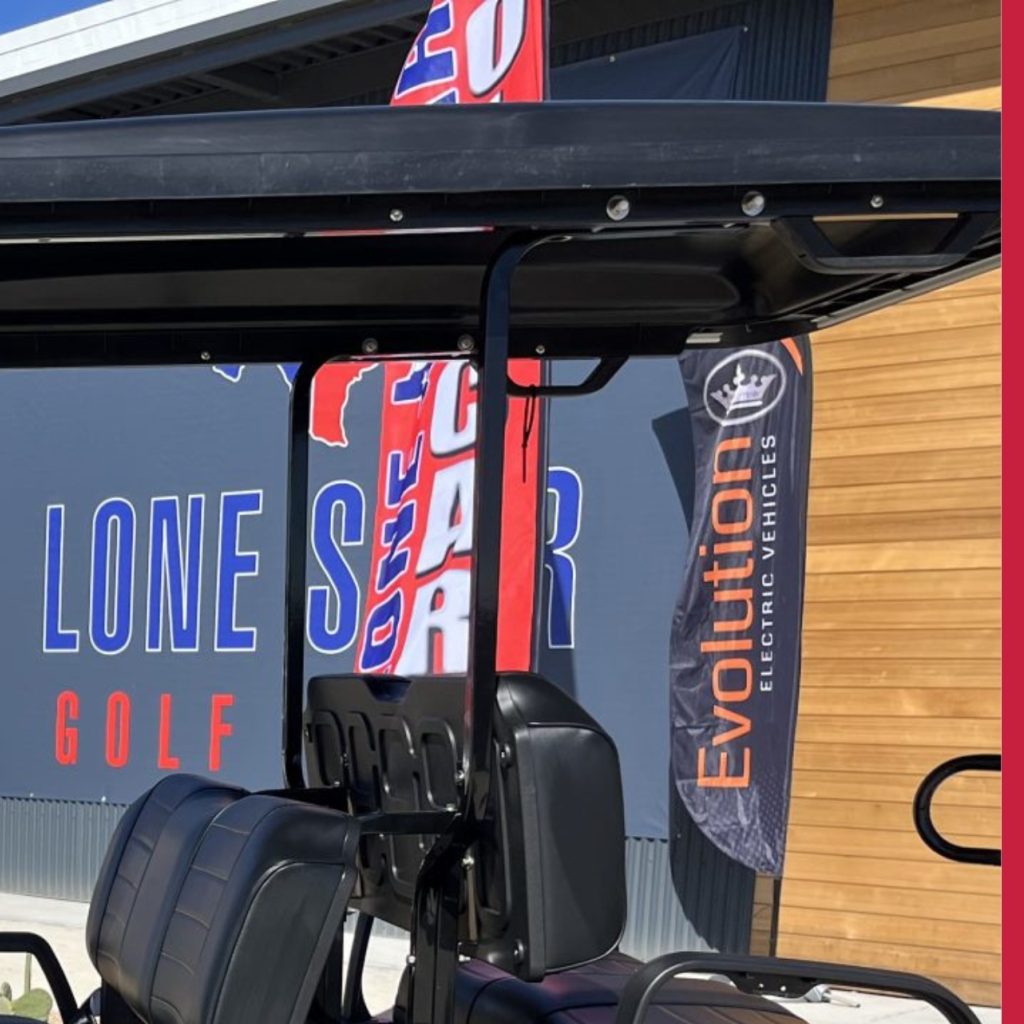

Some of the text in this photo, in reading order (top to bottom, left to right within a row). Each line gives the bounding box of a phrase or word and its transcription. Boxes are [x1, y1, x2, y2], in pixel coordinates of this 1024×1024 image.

[43, 489, 263, 654] LONE
[697, 435, 754, 790] Evolution
[760, 434, 777, 692] ELECTRIC VEHICLES
[54, 690, 234, 771] GOLF
